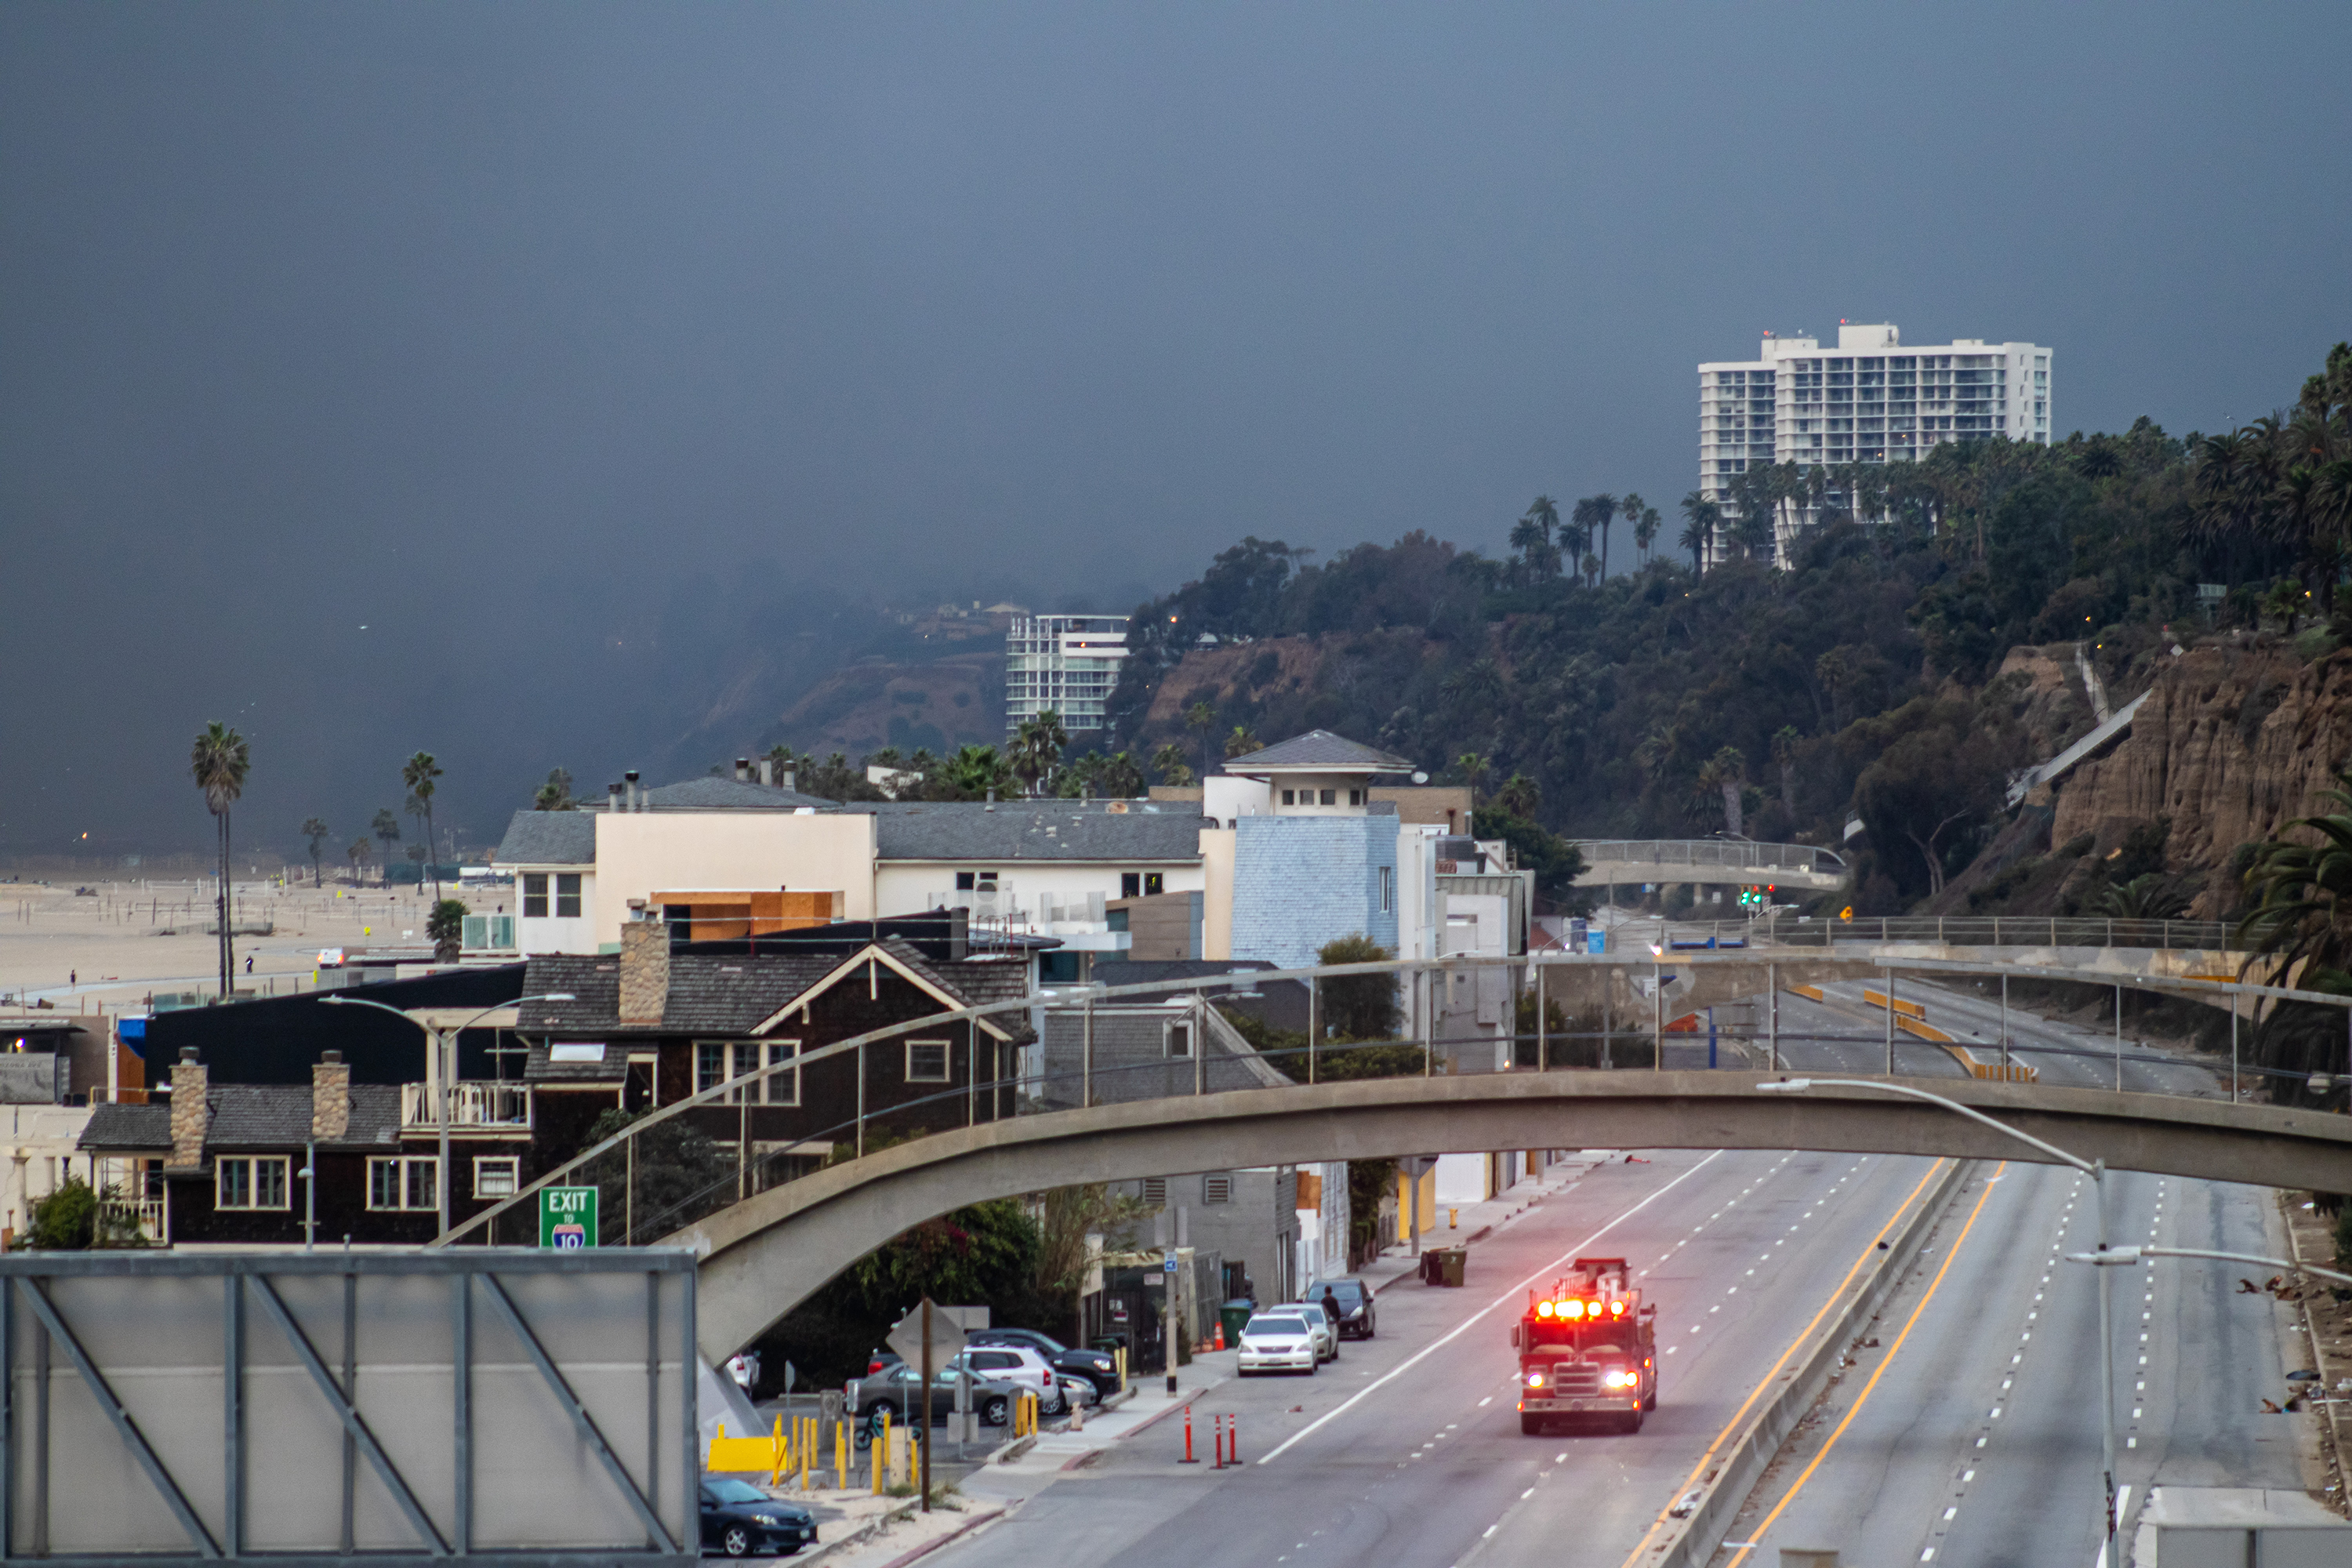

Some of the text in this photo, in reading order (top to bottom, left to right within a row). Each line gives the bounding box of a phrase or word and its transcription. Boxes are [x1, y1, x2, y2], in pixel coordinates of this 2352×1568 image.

[549, 1192, 588, 1212] EXIT
[564, 1214, 574, 1224] TO
[561, 1234, 579, 1249] 10
